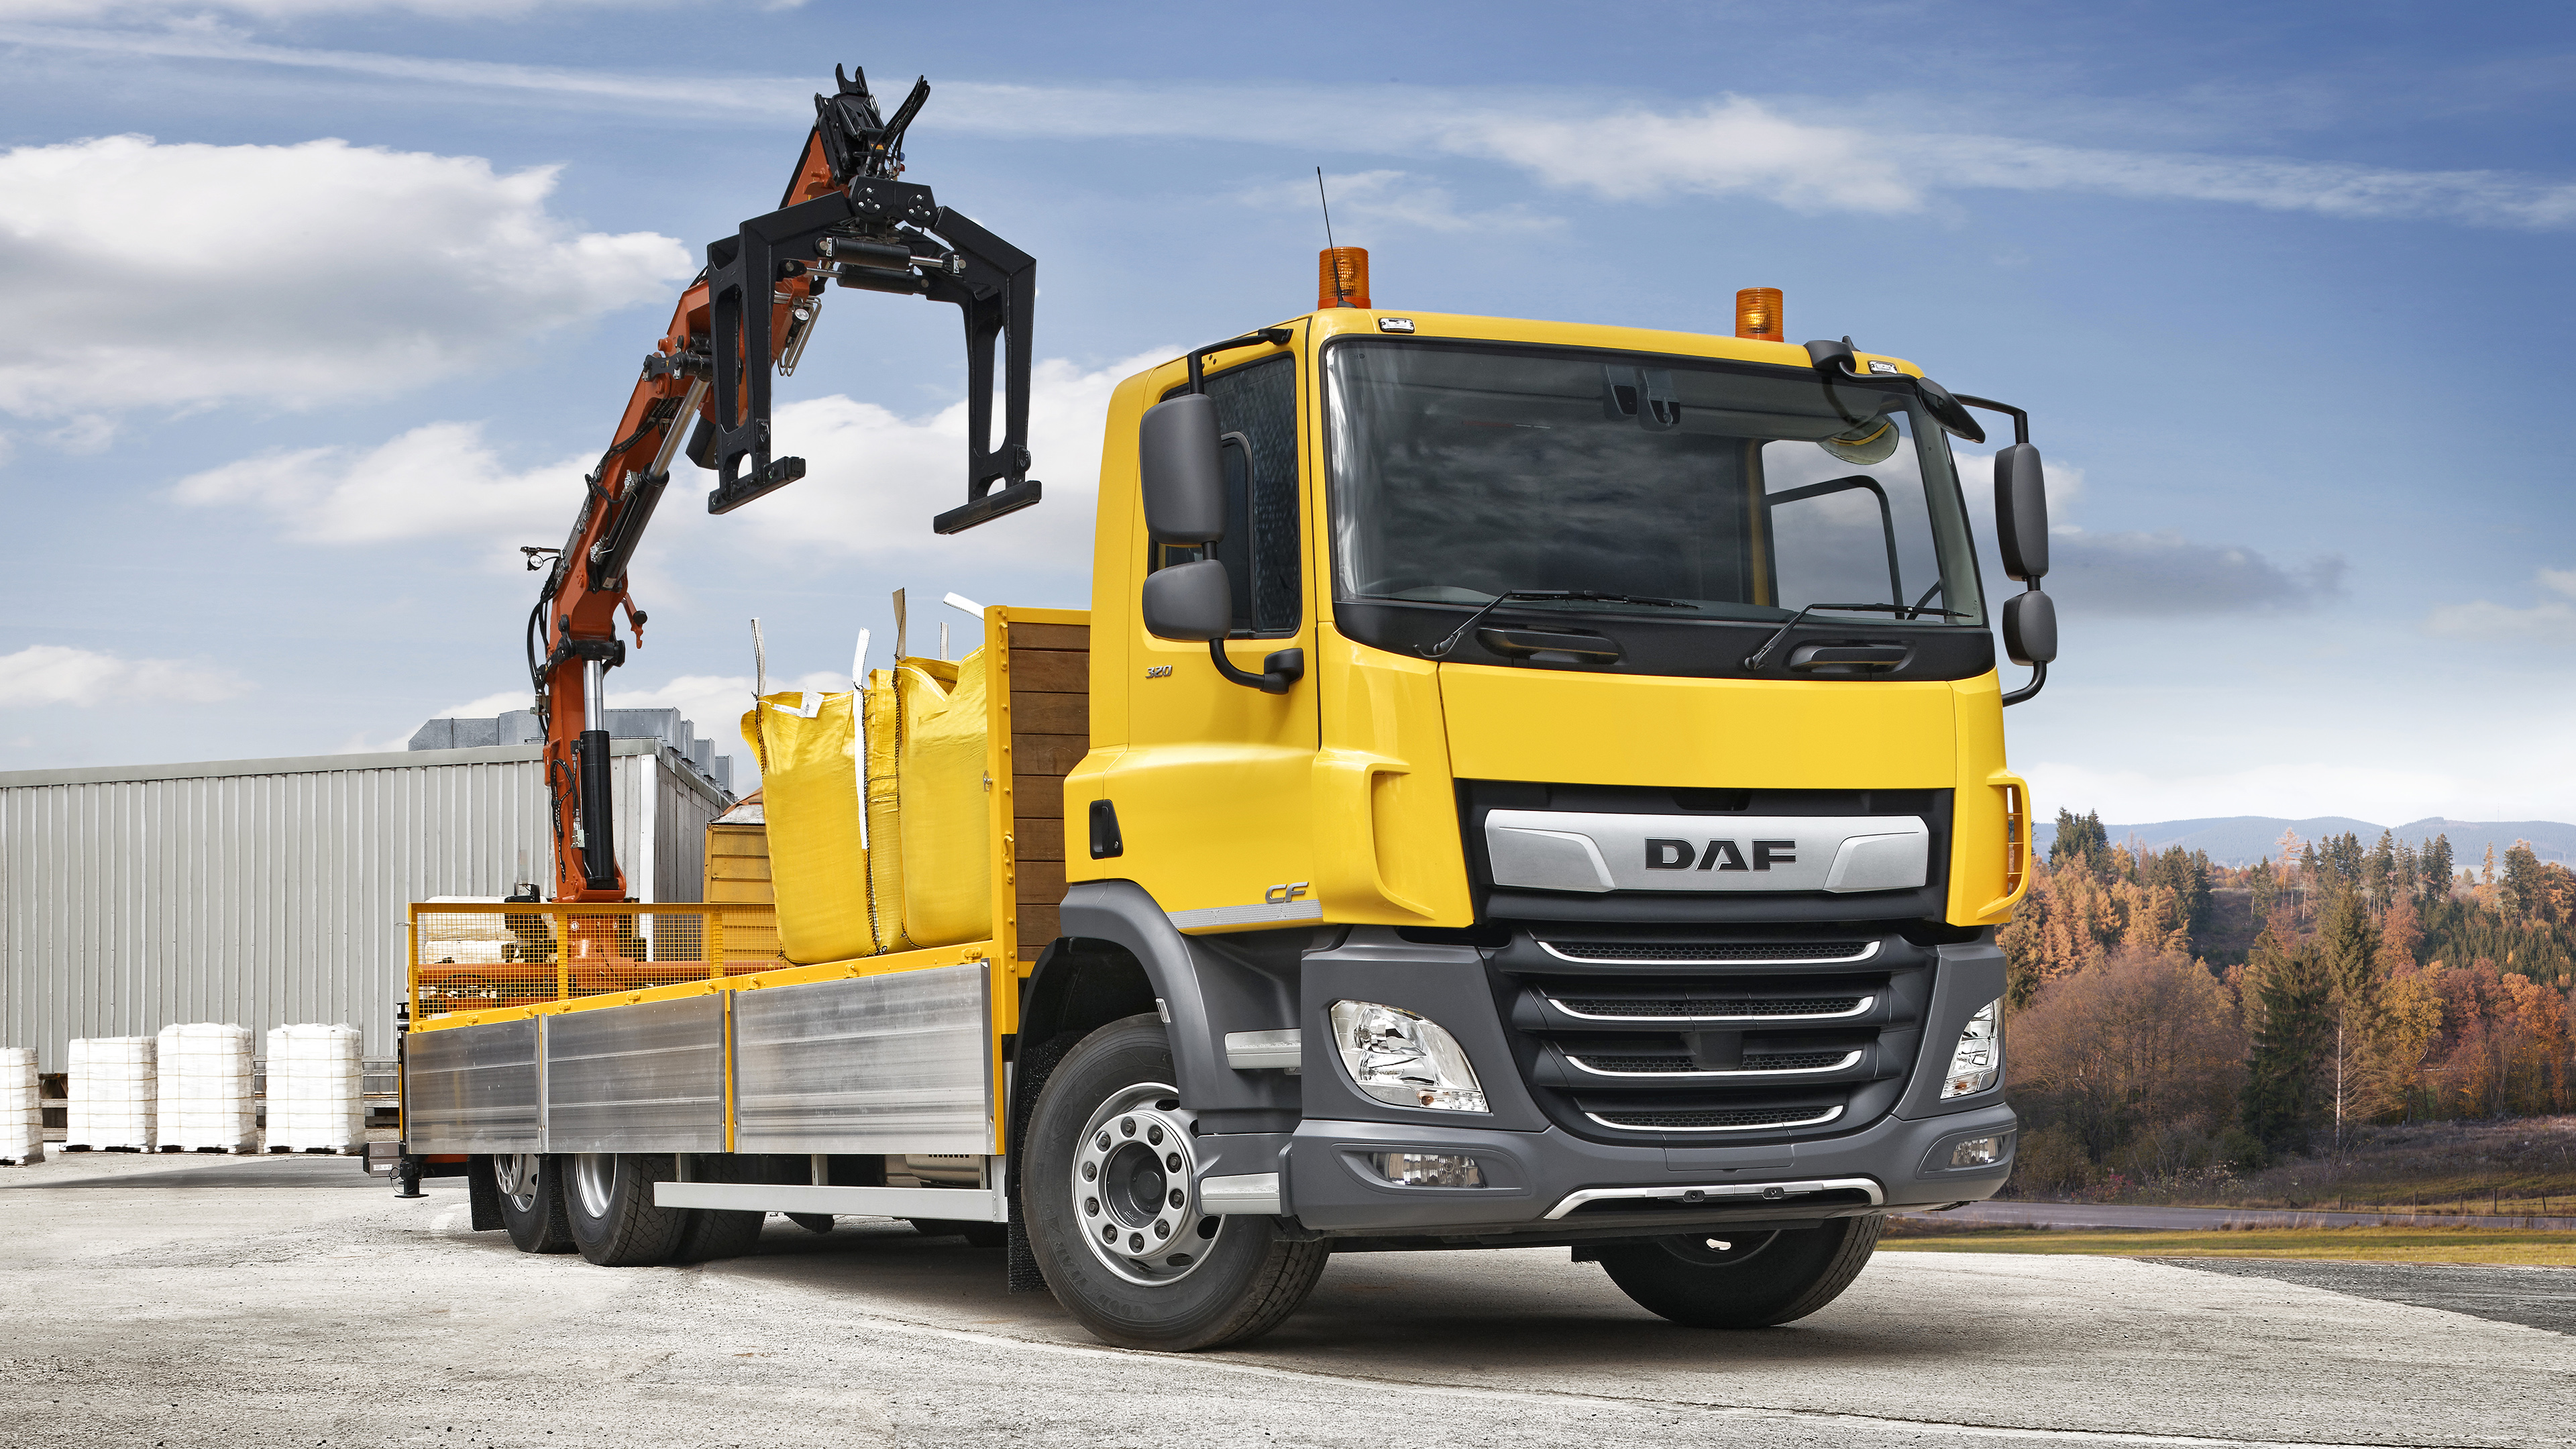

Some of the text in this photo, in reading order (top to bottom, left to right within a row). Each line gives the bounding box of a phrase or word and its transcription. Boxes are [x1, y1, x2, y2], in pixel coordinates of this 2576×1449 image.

[1145, 665, 1173, 679] 320
[1645, 837, 1796, 872] DAF
[1265, 881, 1309, 904] CF
